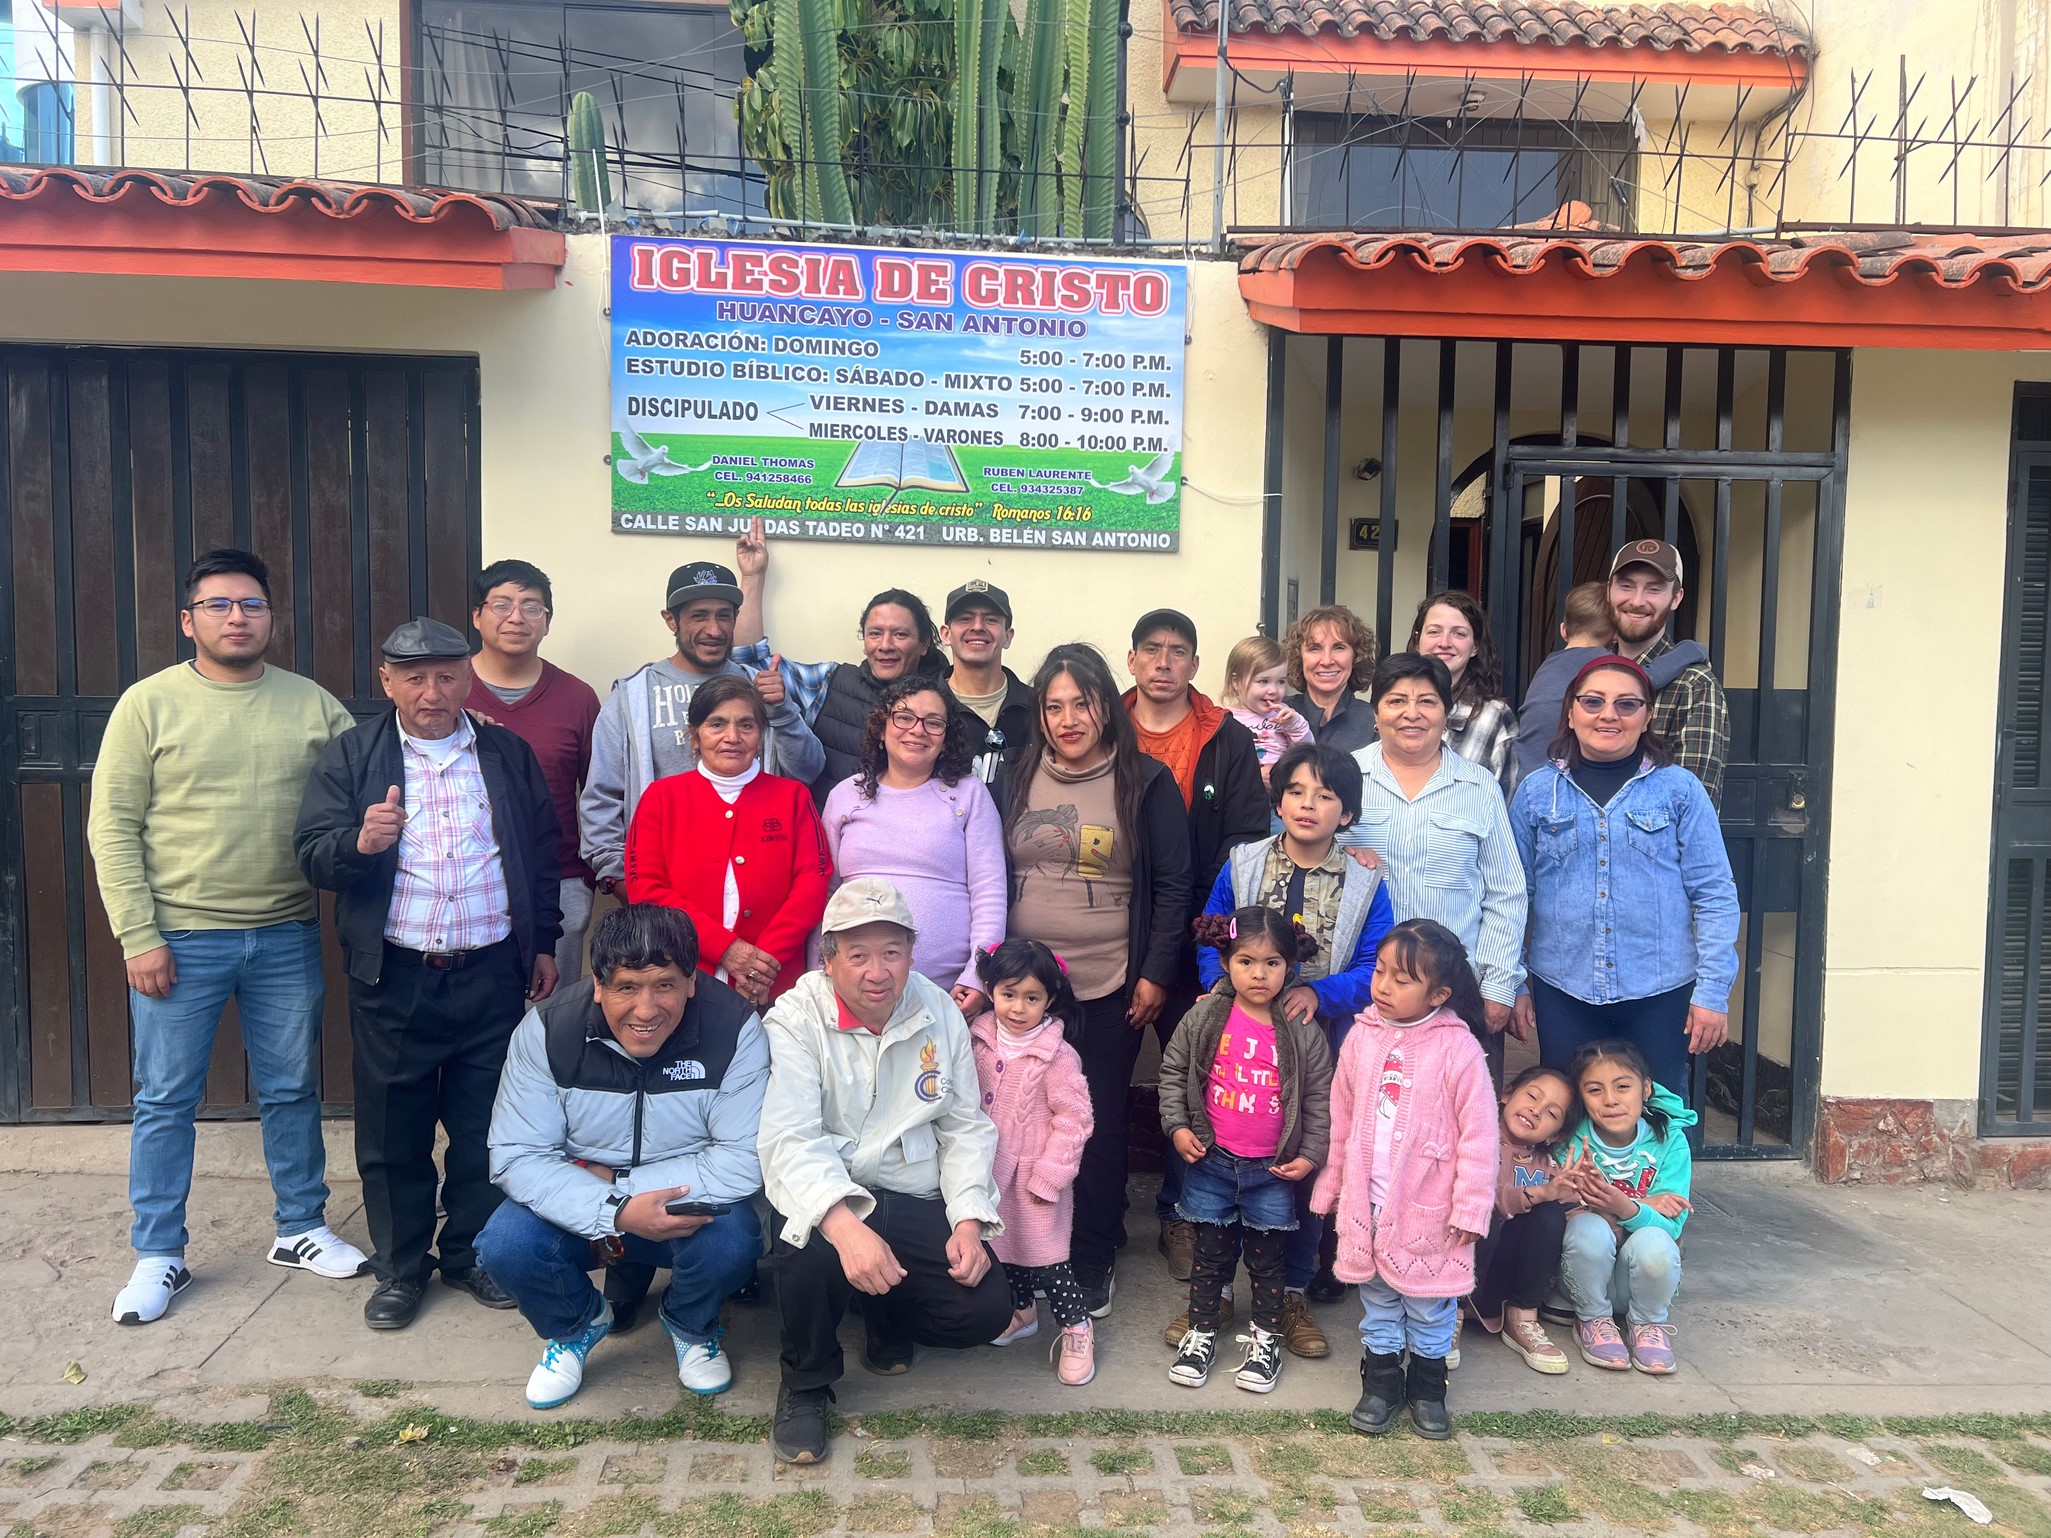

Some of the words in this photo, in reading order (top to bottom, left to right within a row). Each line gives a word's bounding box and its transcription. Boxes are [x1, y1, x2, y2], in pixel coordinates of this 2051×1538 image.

[634, 246, 863, 300] IGLESIA
[876, 258, 952, 305] DE
[964, 264, 1168, 315] CRISTO
[717, 302, 872, 327] HUANCAYO
[897, 312, 953, 332] SAN
[962, 315, 1087, 338] ANTONIO
[626, 330, 767, 351] ADORACIÓN:
[774, 337, 879, 357] DOMINGO
[1020, 350, 1063, 366] 5:00
[1083, 353, 1126, 369] 7:00
[1132, 355, 1172, 371] P.M.
[627, 358, 724, 378] ESTUDIO
[733, 360, 829, 382] BÍBLICO:
[835, 366, 924, 387] SÁBADO
[944, 373, 1012, 391] MIXTO
[1019, 377, 1063, 394] 5:00
[1082, 380, 1125, 396] 7:00
[1132, 382, 1171, 398] P.M.
[627, 396, 759, 421] DISCIPULADO
[809, 395, 905, 413] VIERNES
[925, 400, 999, 418] DAMAS
[1018, 405, 1062, 421] 7:00
[1081, 408, 1124, 424] 9:00
[1130, 410, 1169, 425] P.M.
[809, 422, 908, 442] MIERCOLES
[924, 427, 1003, 446] VARONES
[1019, 432, 1059, 448] 8:00
[1077, 434, 1127, 451] 10:00
[1133, 437, 1168, 452] P.M.
[712, 455, 757, 466] DANIEL
[761, 457, 815, 469] THOMAS
[983, 467, 1025, 478] RUBEN
[1029, 469, 1092, 480] LAURENTE
[715, 471, 742, 481] CEL.
[746, 472, 812, 484] 941258466
[991, 483, 1017, 493] CEL.
[1021, 484, 1084, 495] 934325387
[745, 493, 801, 513] Saludan
[805, 497, 842, 511] todas
[844, 498, 865, 512] las
[920, 501, 936, 516] de
[992, 503, 1051, 522] Romanos
[1056, 506, 1092, 521] 16:16
[620, 514, 679, 531] CALLE
[685, 516, 722, 532] SAN
[805, 521, 865, 538] TADEO
[894, 524, 924, 540] 421
[942, 526, 983, 542] URB.
[990, 526, 1046, 545] BELÉN
[1052, 530, 1086, 546] SAN
[1092, 532, 1171, 548] ANTONIO
[1359, 524, 1380, 540] 42
[663, 1066, 692, 1076] NORTH
[674, 1060, 692, 1068] THE
[670, 1073, 692, 1081] FACE
